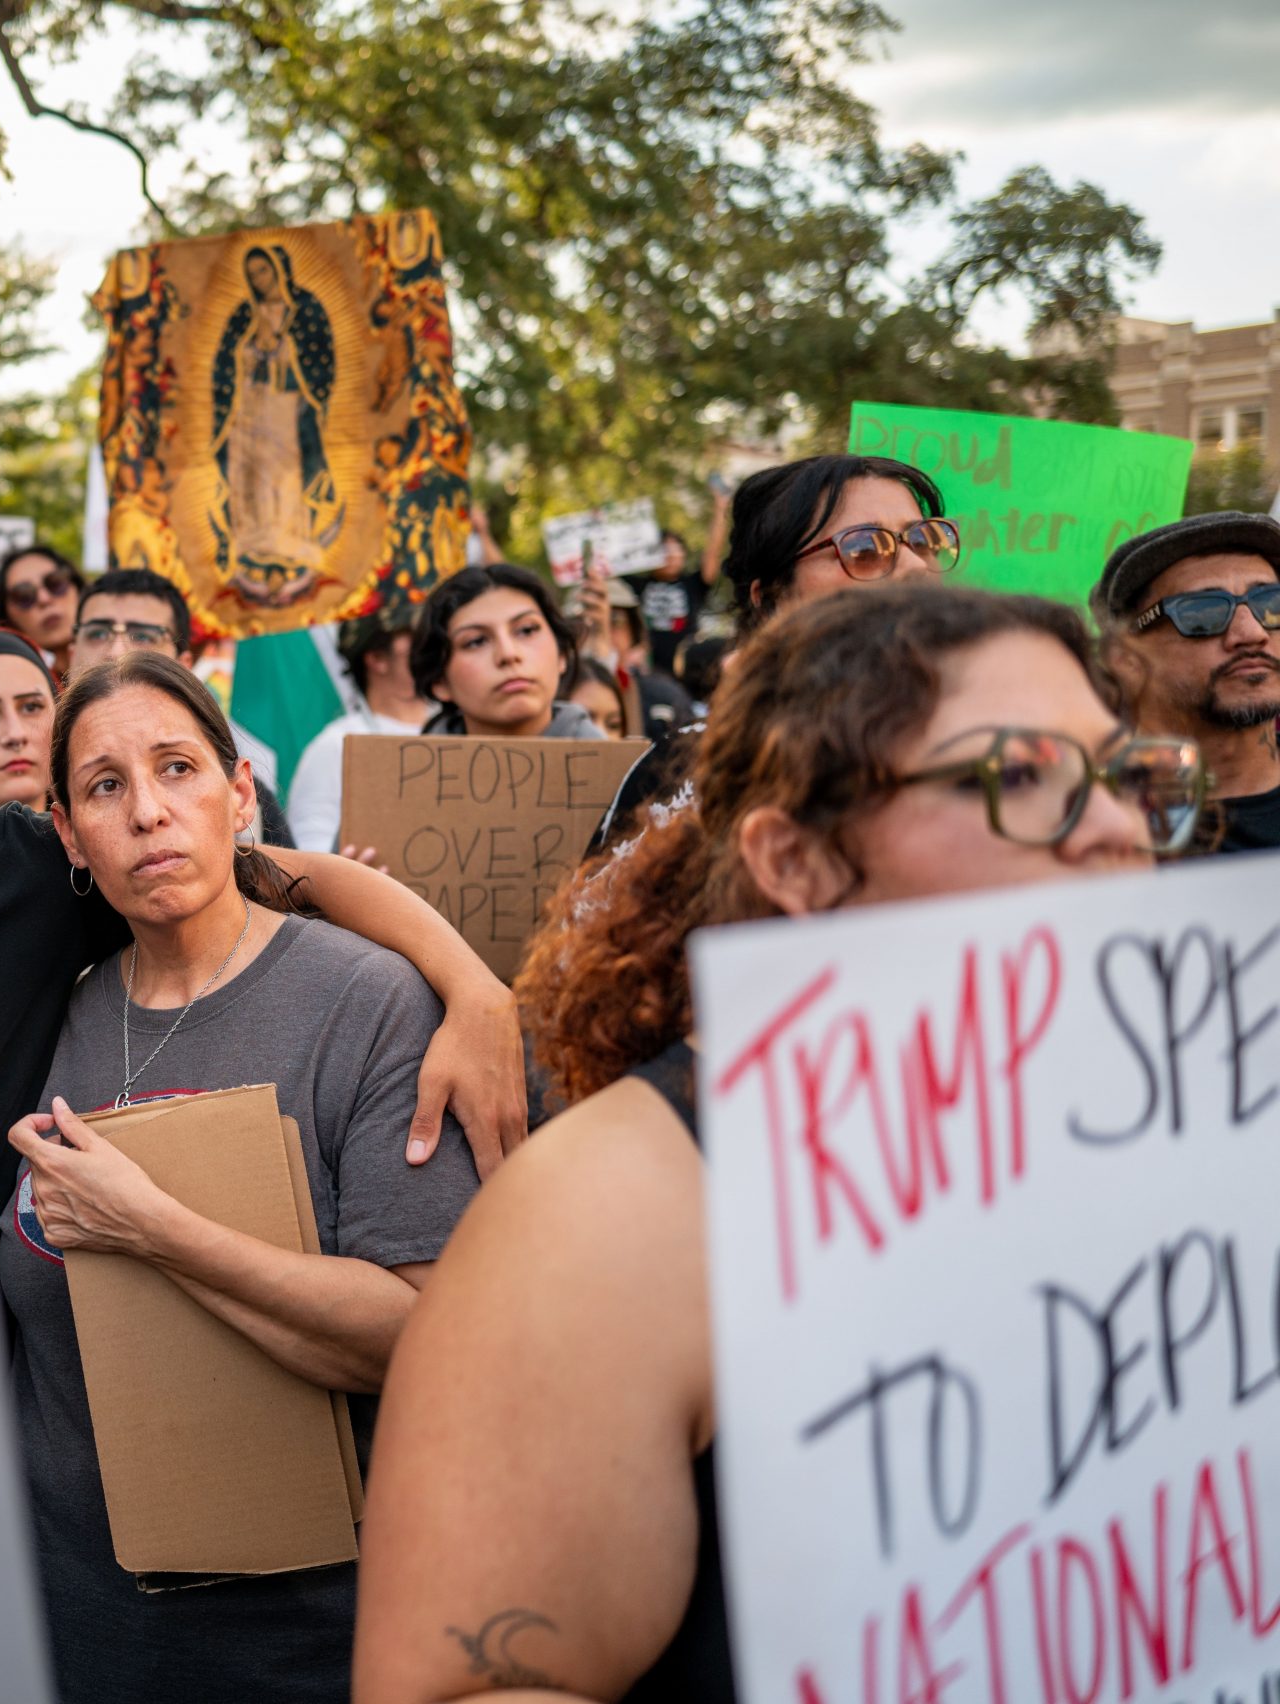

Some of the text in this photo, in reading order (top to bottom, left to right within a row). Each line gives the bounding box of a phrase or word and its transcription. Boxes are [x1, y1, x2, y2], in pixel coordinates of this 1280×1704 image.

[855, 415, 1012, 490] Proud
[399, 740, 613, 810] PEOPLE
[403, 823, 571, 881] OVER
[710, 922, 1063, 1308] TRUMP
[800, 1226, 1280, 1562] TO DEPL
